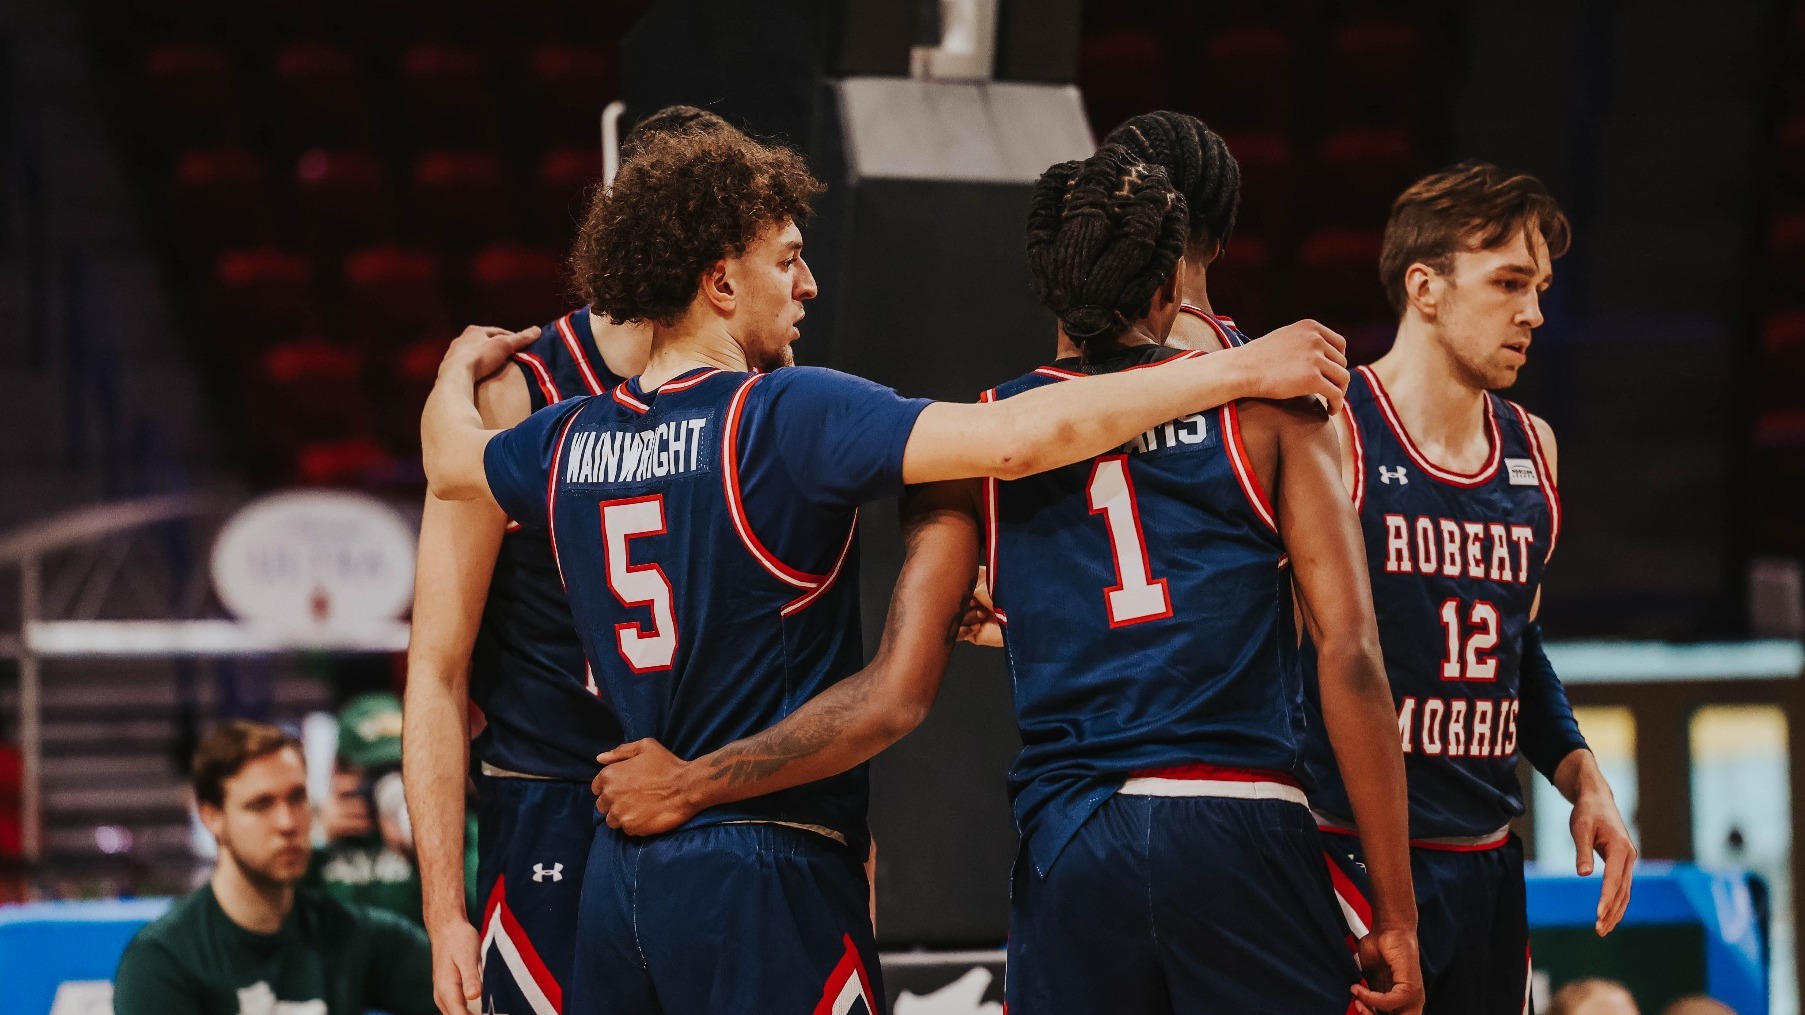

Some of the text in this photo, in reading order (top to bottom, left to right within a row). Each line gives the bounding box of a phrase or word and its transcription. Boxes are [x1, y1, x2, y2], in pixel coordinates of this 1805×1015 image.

[599, 493, 679, 674] 5
[1085, 453, 1174, 629] 1
[1384, 513, 1534, 584] ROBERT
[1440, 598, 1499, 681] 12
